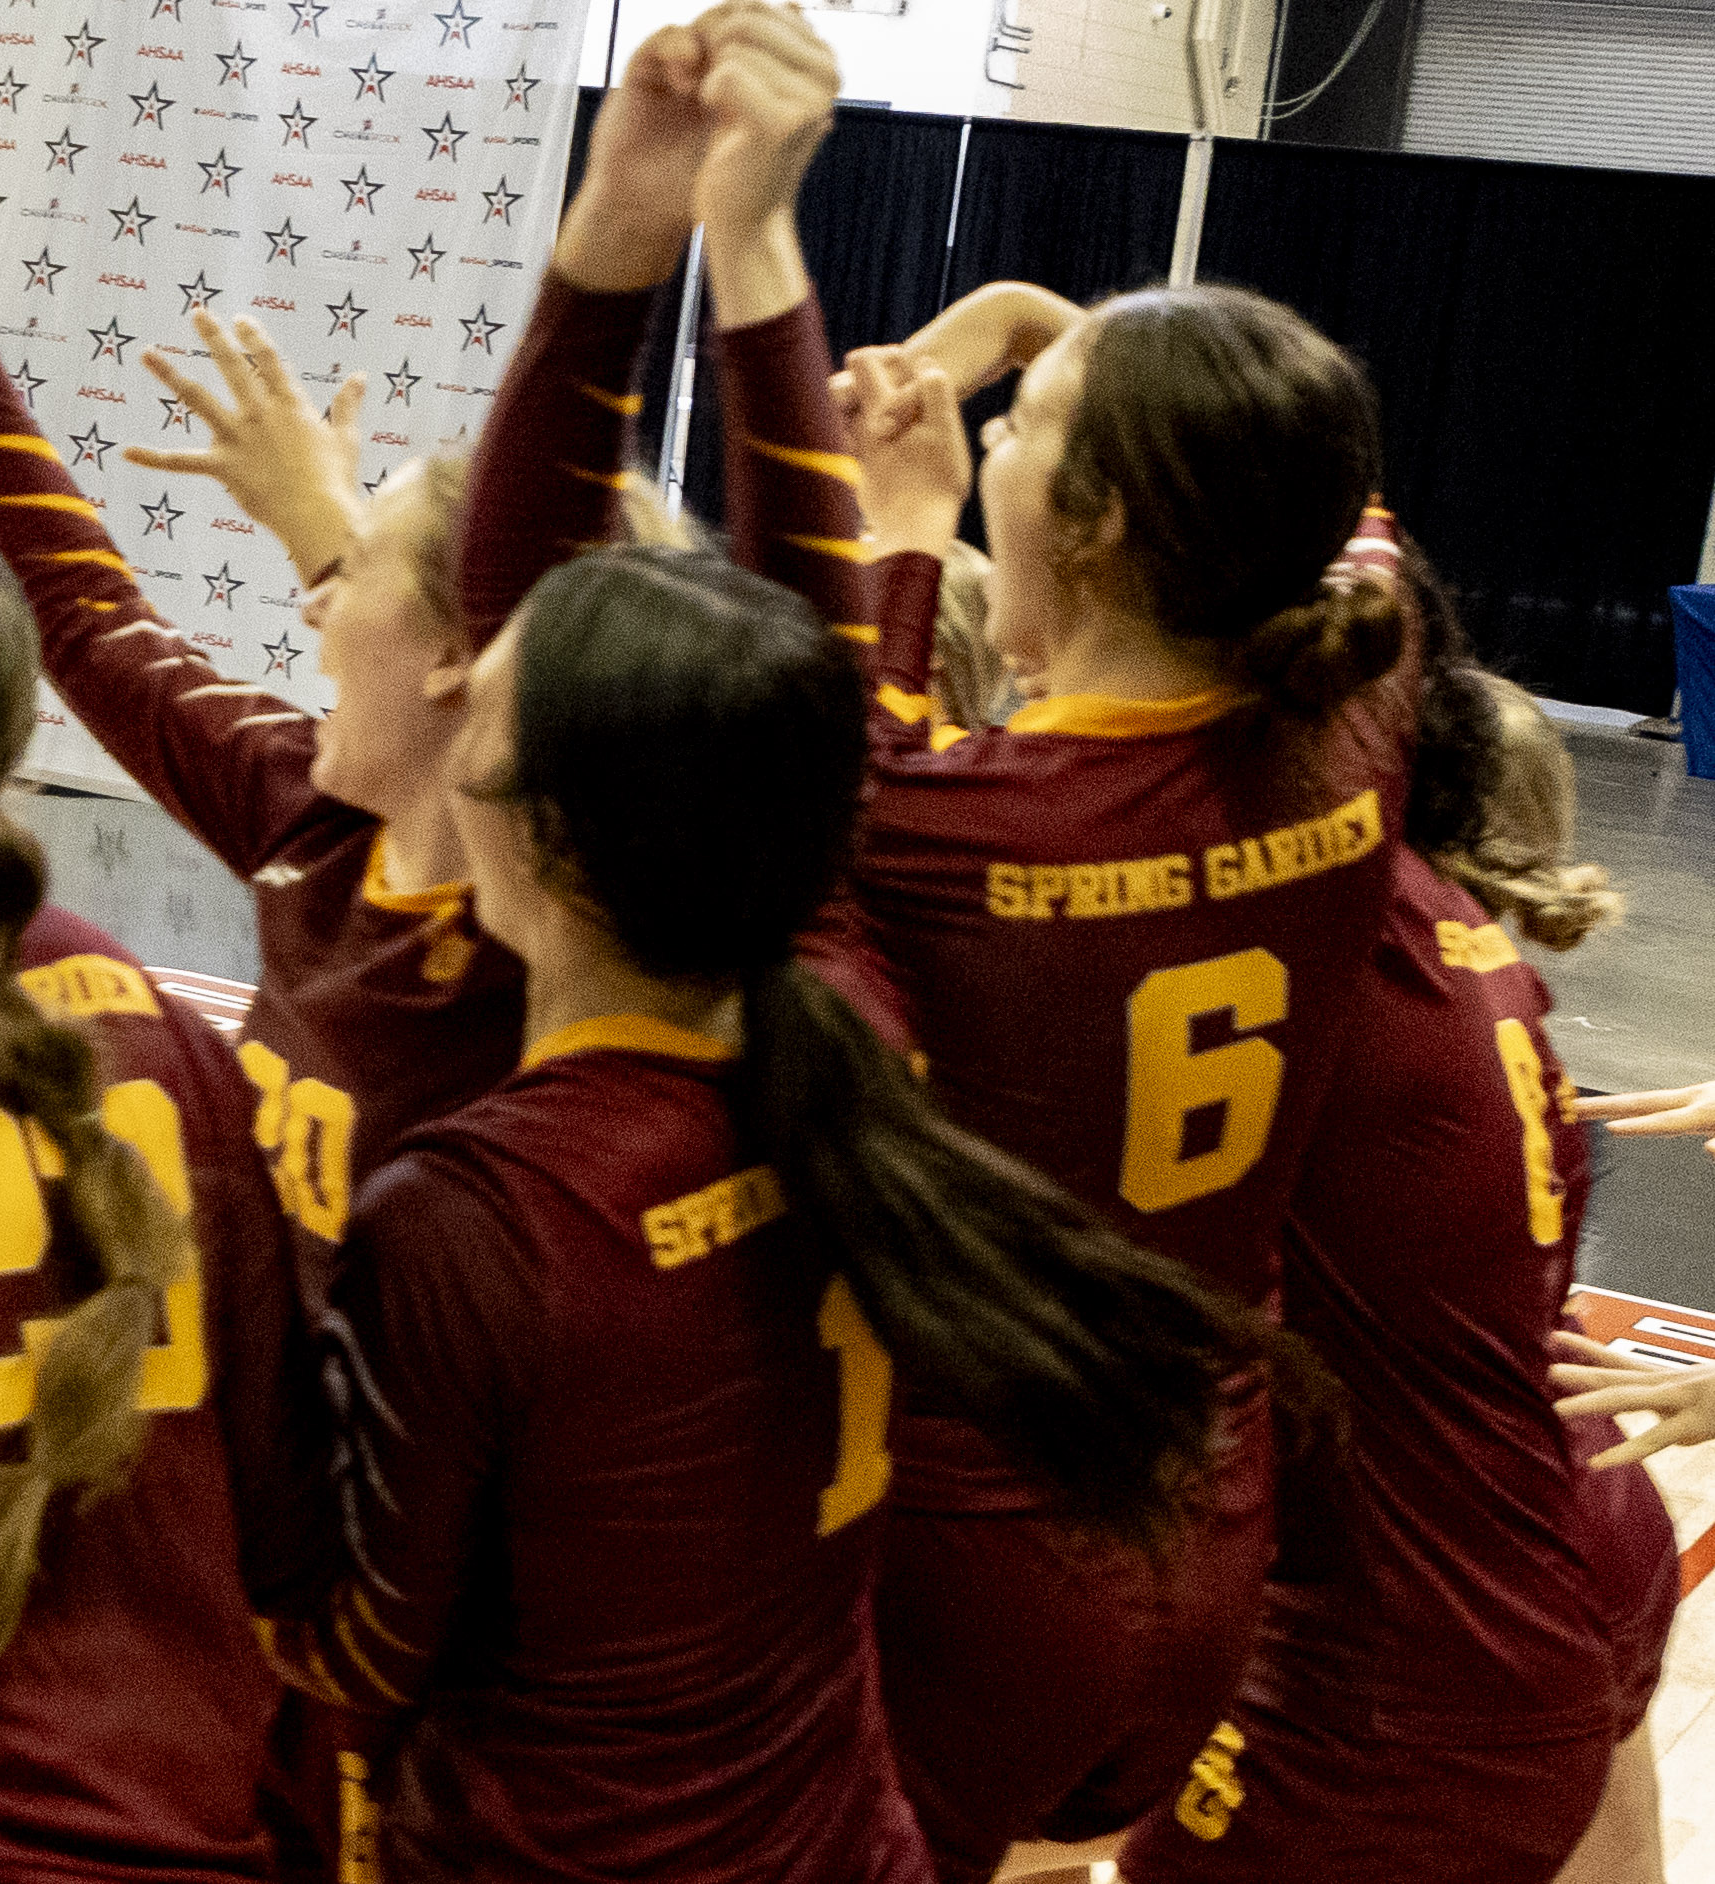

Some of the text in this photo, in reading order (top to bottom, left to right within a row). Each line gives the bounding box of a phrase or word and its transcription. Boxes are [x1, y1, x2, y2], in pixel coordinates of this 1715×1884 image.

[987, 789, 1384, 921] SPRING GARDEN
[1118, 946, 1289, 1215] 6
